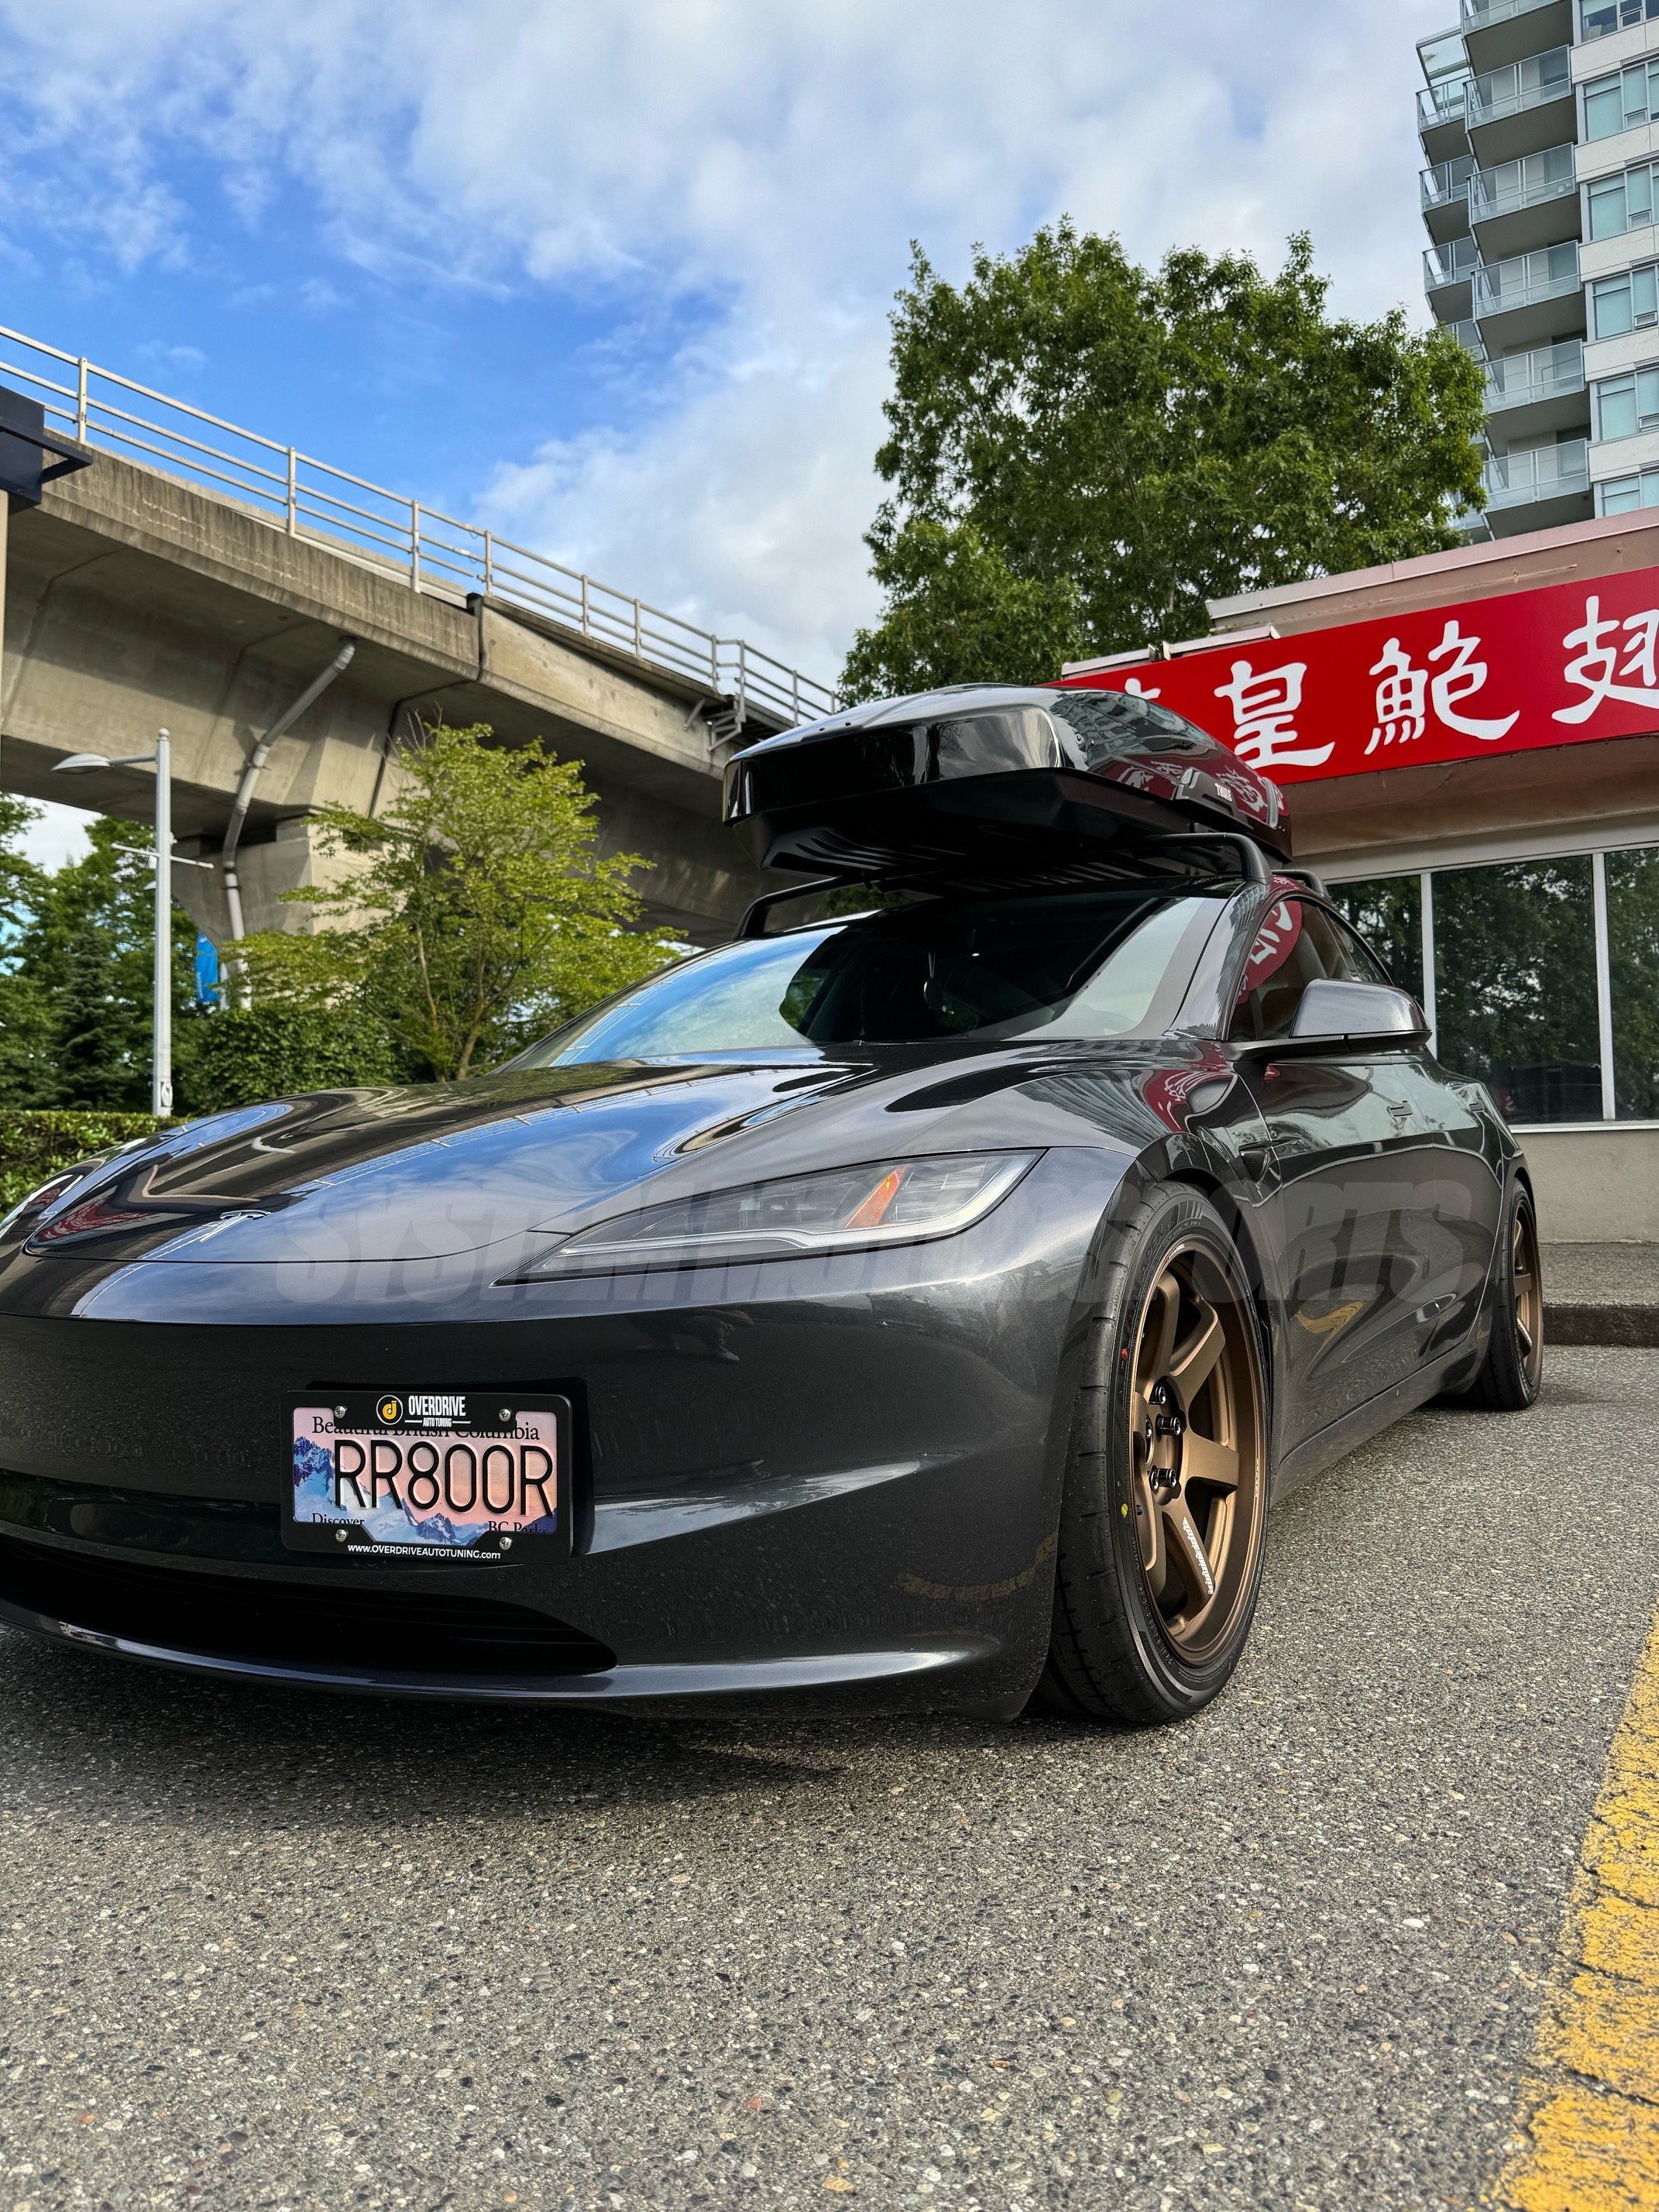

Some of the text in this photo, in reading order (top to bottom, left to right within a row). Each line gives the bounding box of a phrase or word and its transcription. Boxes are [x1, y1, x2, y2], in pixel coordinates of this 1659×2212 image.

[1125, 595, 1659, 768] 皇鮑翅
[408, 1396, 466, 1416] OVERDRIVE
[423, 1417, 435, 1427] AUTO
[335, 1439, 553, 1517] RR800R
[348, 1544, 501, 1560] www.OVERDRIVEAUTOTUNING.com
